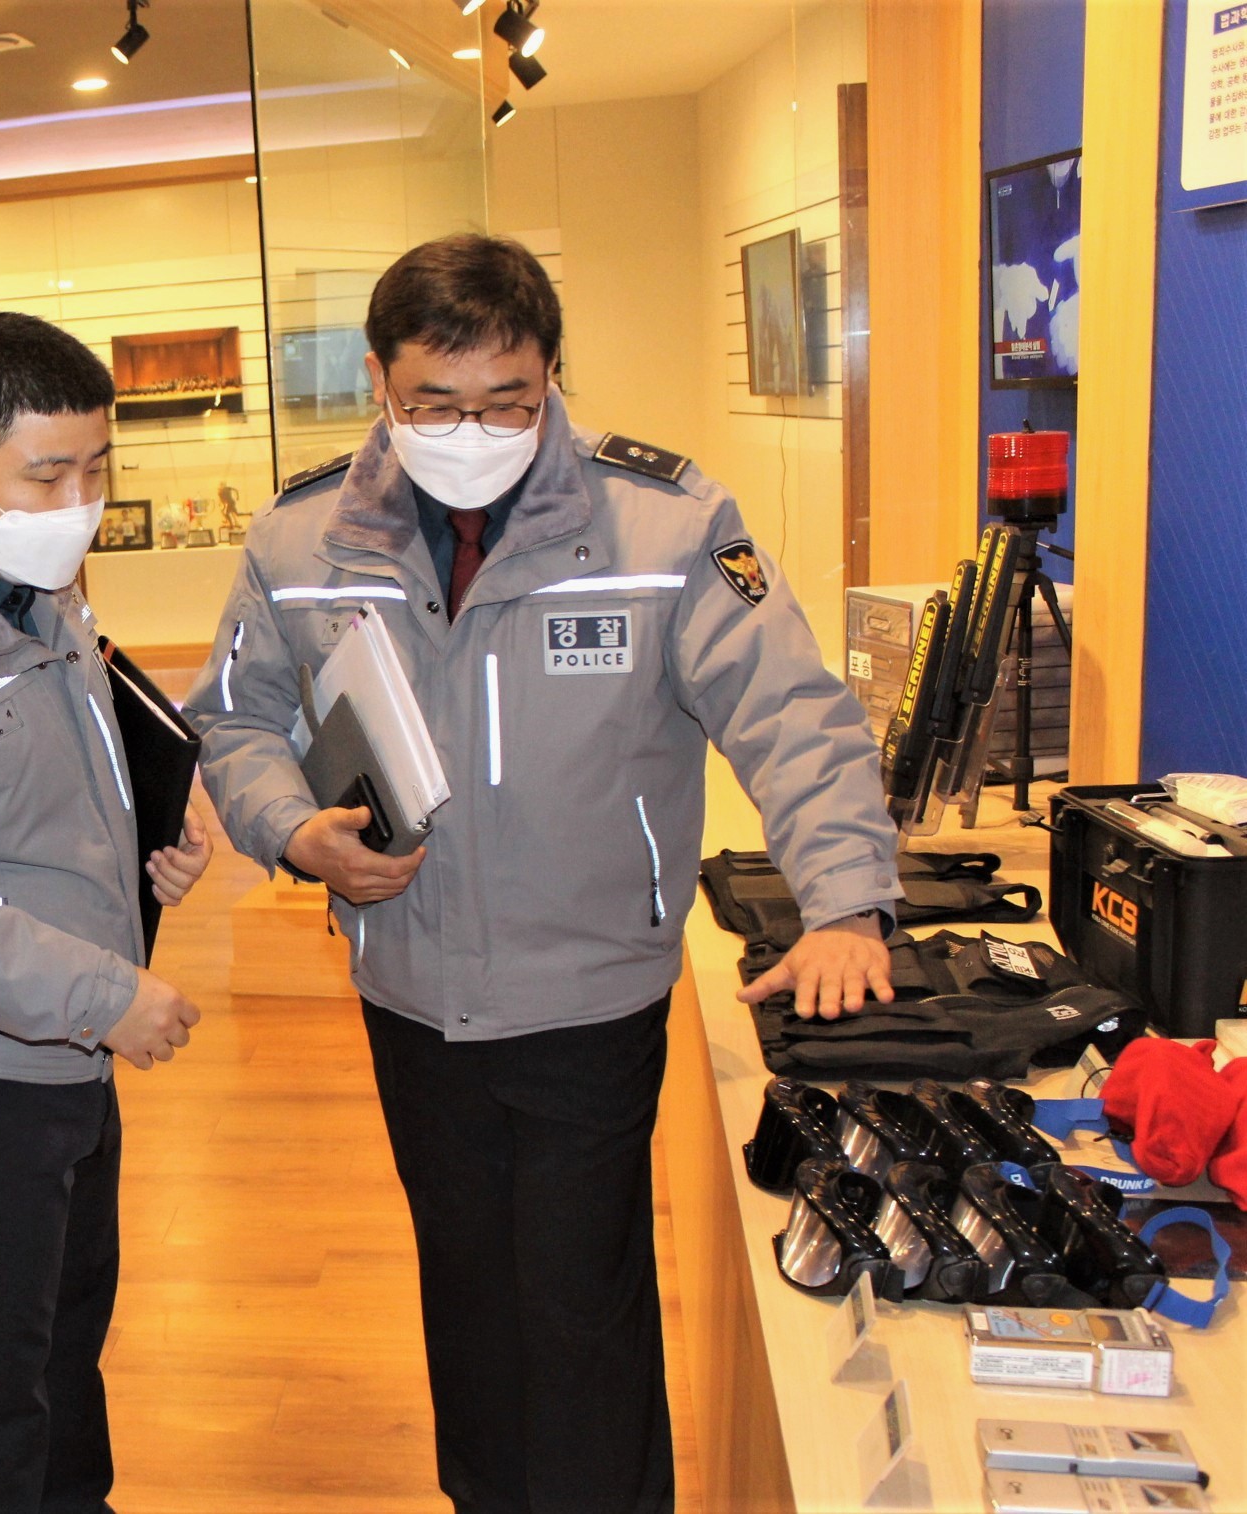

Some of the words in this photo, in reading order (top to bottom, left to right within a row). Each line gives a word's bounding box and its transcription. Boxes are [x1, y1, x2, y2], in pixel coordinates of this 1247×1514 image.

[553, 618, 622, 648] 경찰
[554, 652, 624, 667] POLICE
[902, 611, 934, 714] SCANNER
[1092, 881, 1138, 935] KCS
